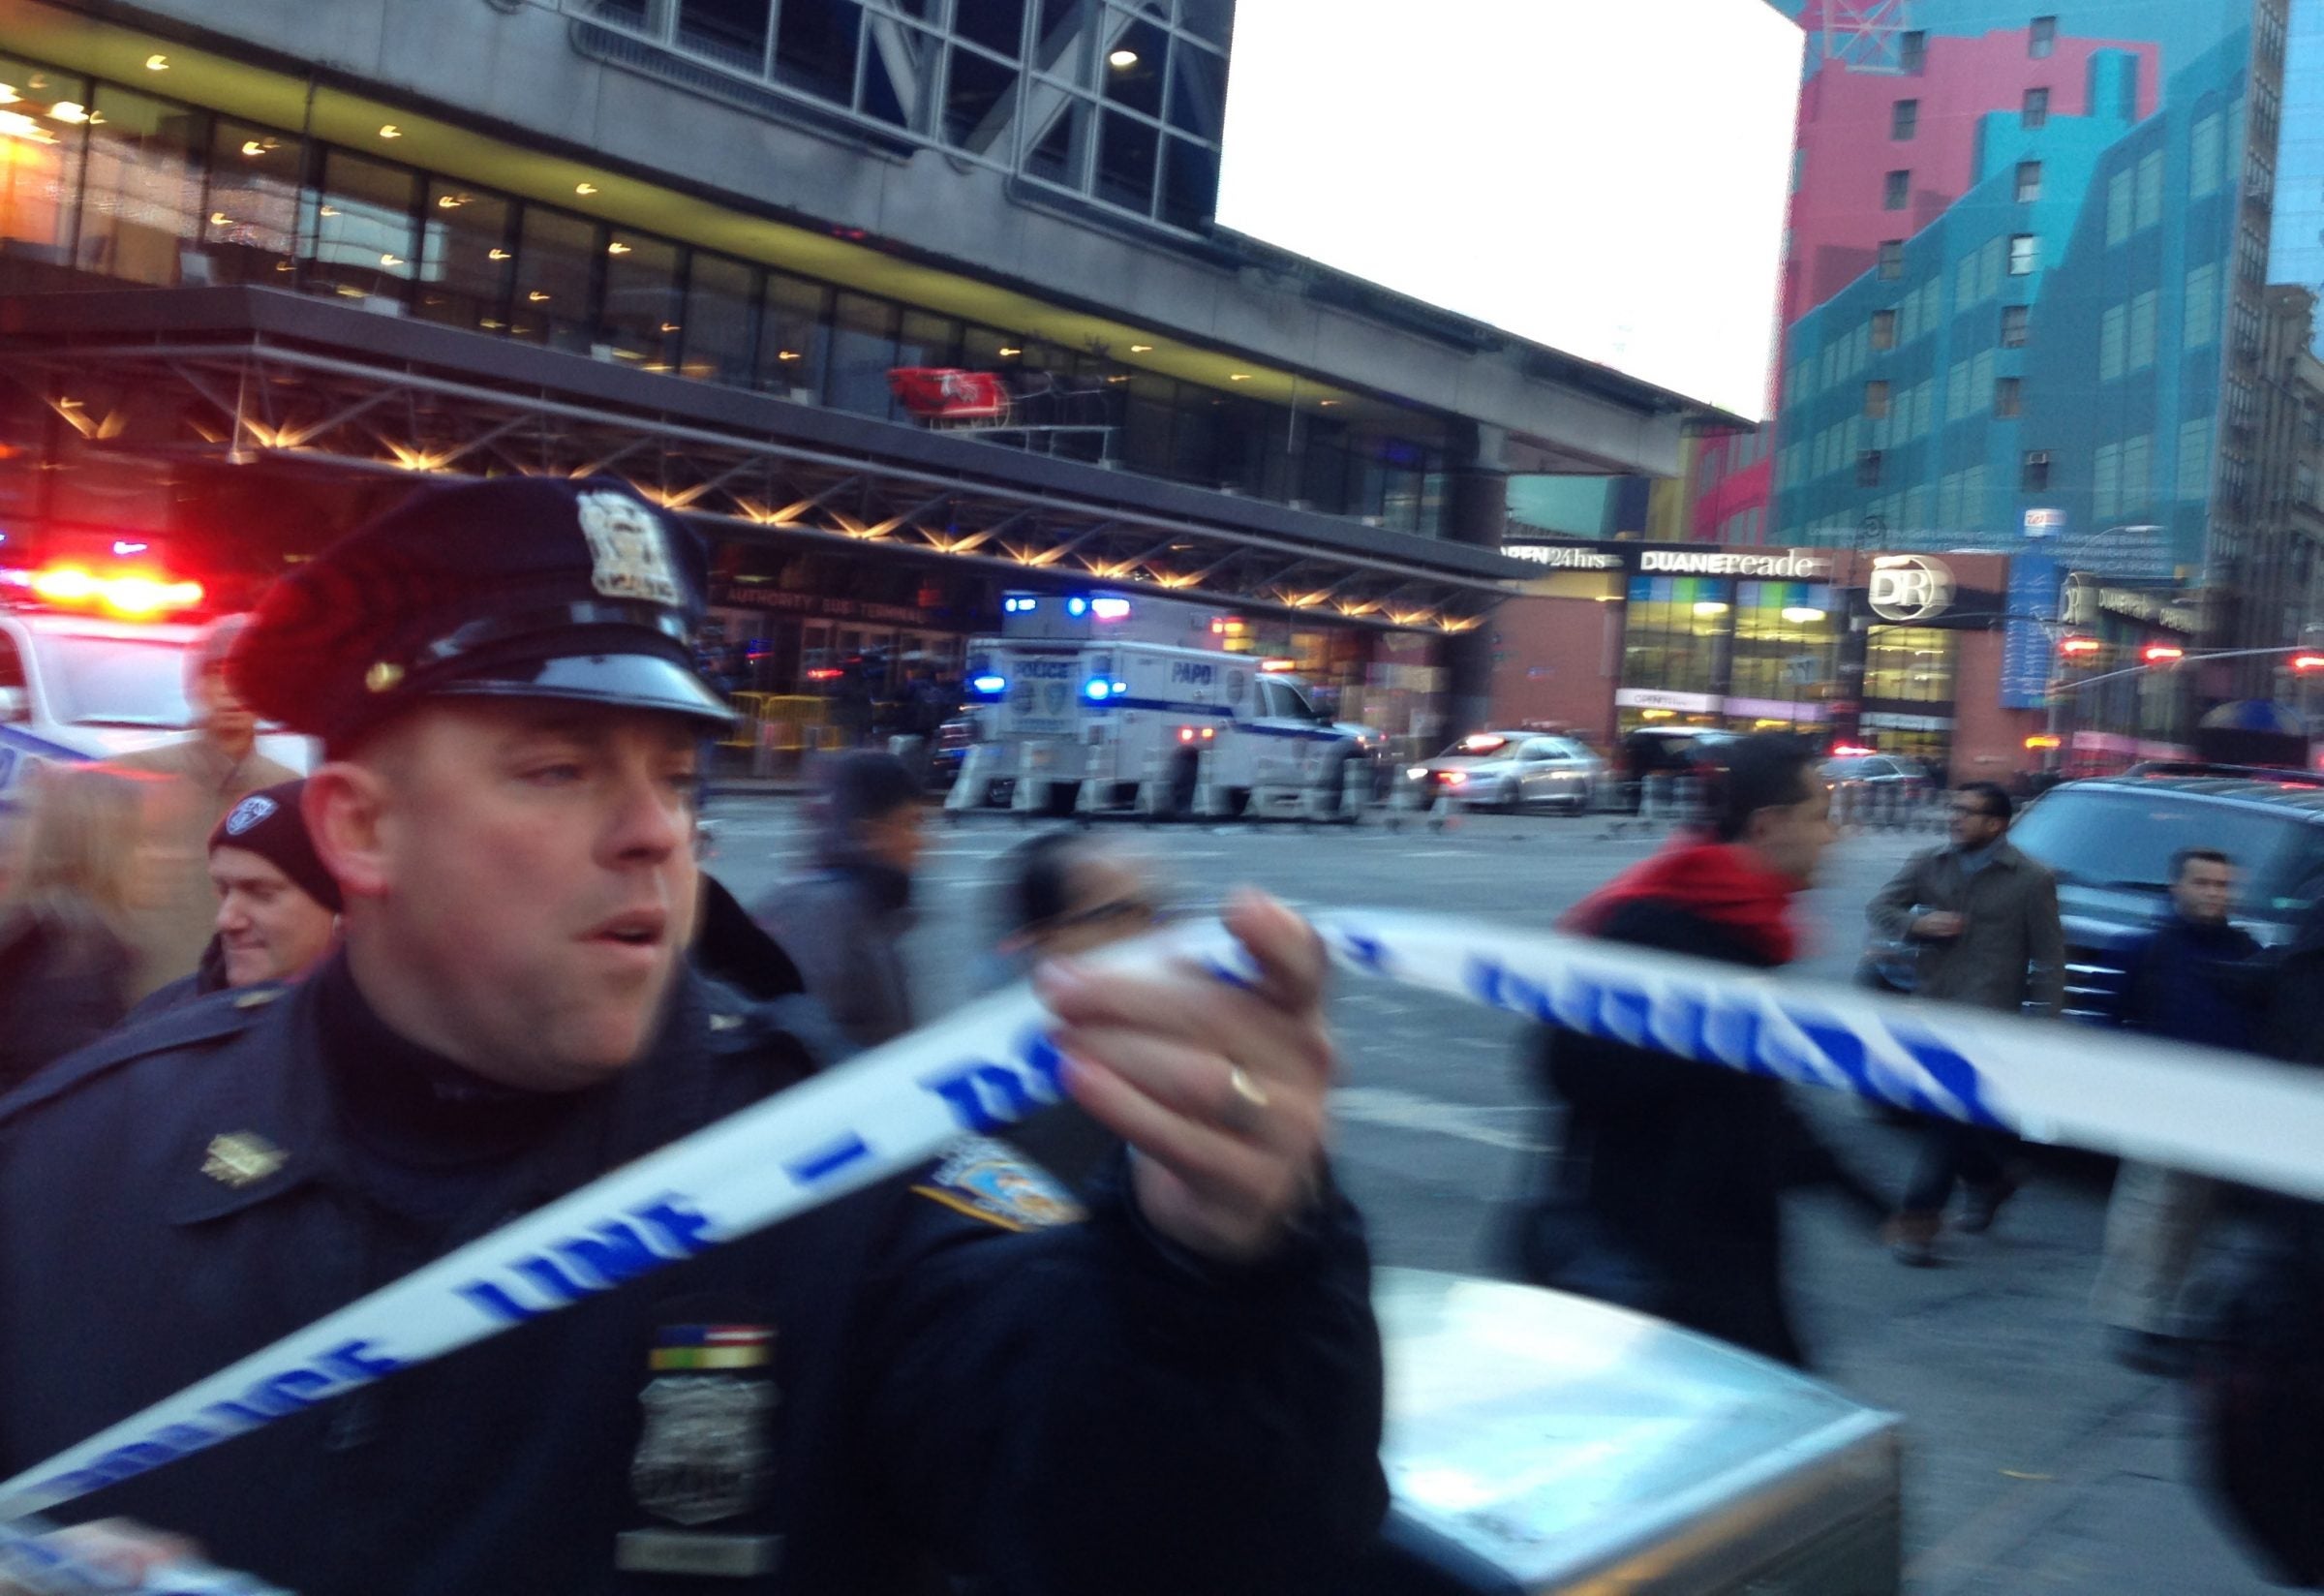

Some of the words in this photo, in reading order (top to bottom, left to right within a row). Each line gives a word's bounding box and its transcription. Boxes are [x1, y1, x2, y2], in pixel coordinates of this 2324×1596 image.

[1867, 568, 1933, 607] DR
[1014, 661, 1069, 679] POLICE
[1171, 660, 1212, 685] PAPD
